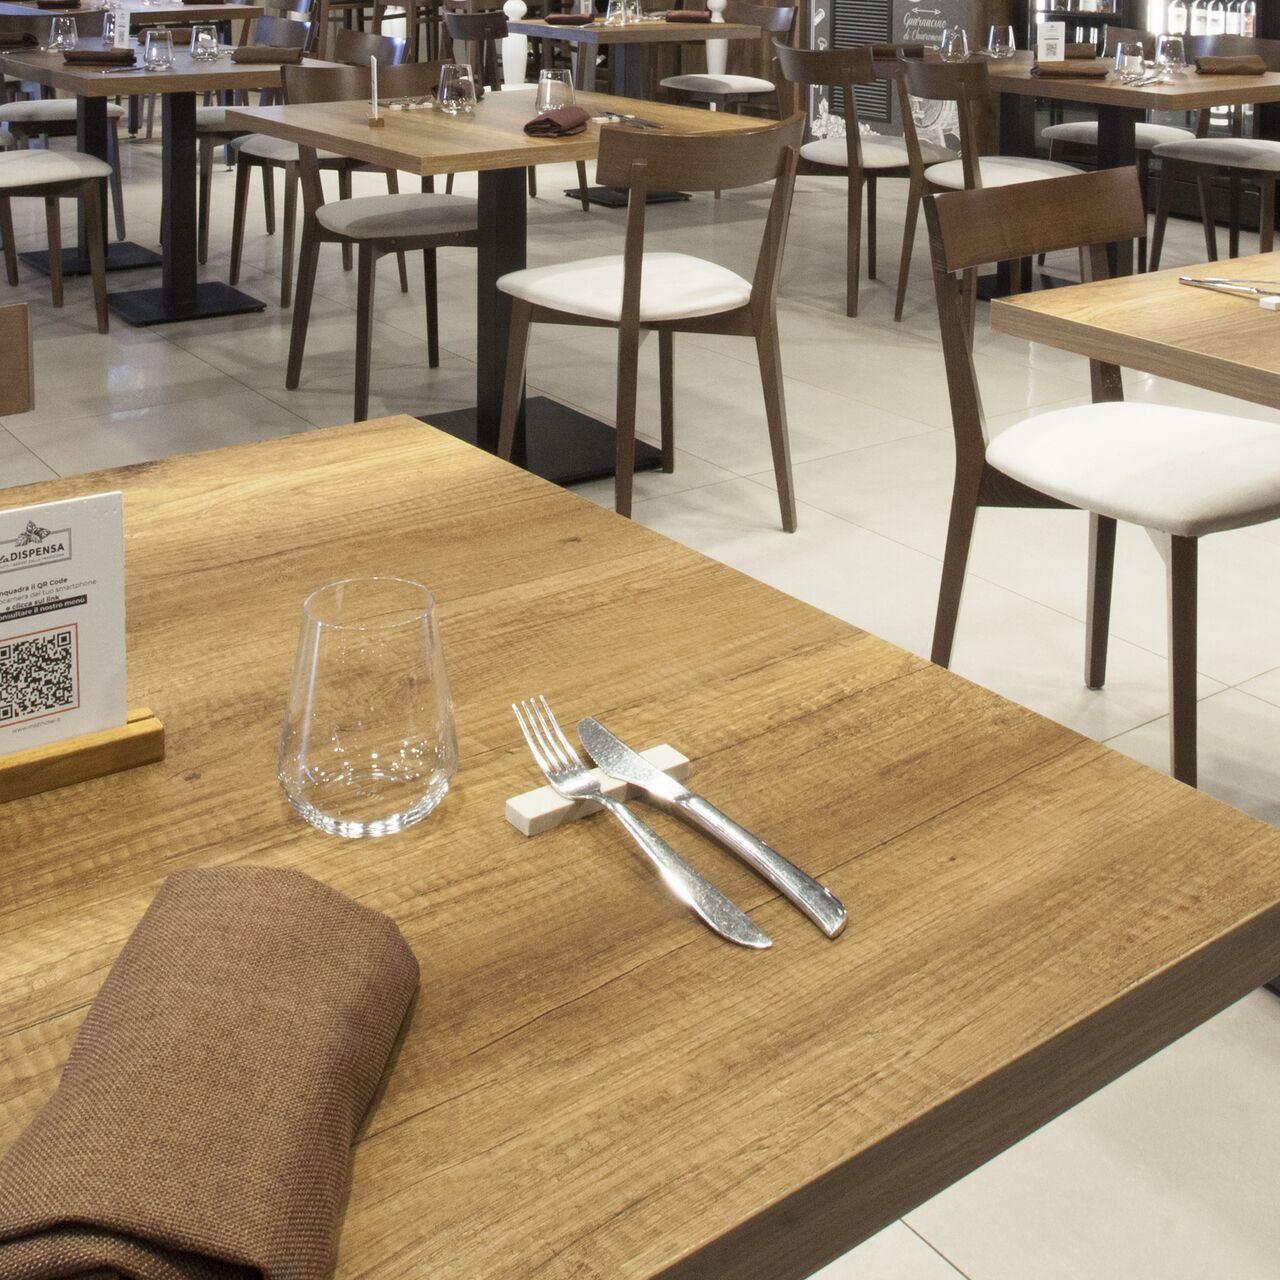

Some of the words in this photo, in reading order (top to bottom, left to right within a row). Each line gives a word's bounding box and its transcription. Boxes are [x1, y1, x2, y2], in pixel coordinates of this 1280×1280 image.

[10, 543, 65, 562] DISPENSA
[37, 582, 48, 590] QR
[49, 578, 68, 587] Code
[42, 589, 54, 597] tuo
[55, 580, 97, 593] smartphone
[12, 601, 33, 610] clicca
[46, 595, 60, 603] link
[40, 602, 64, 612] nostro
